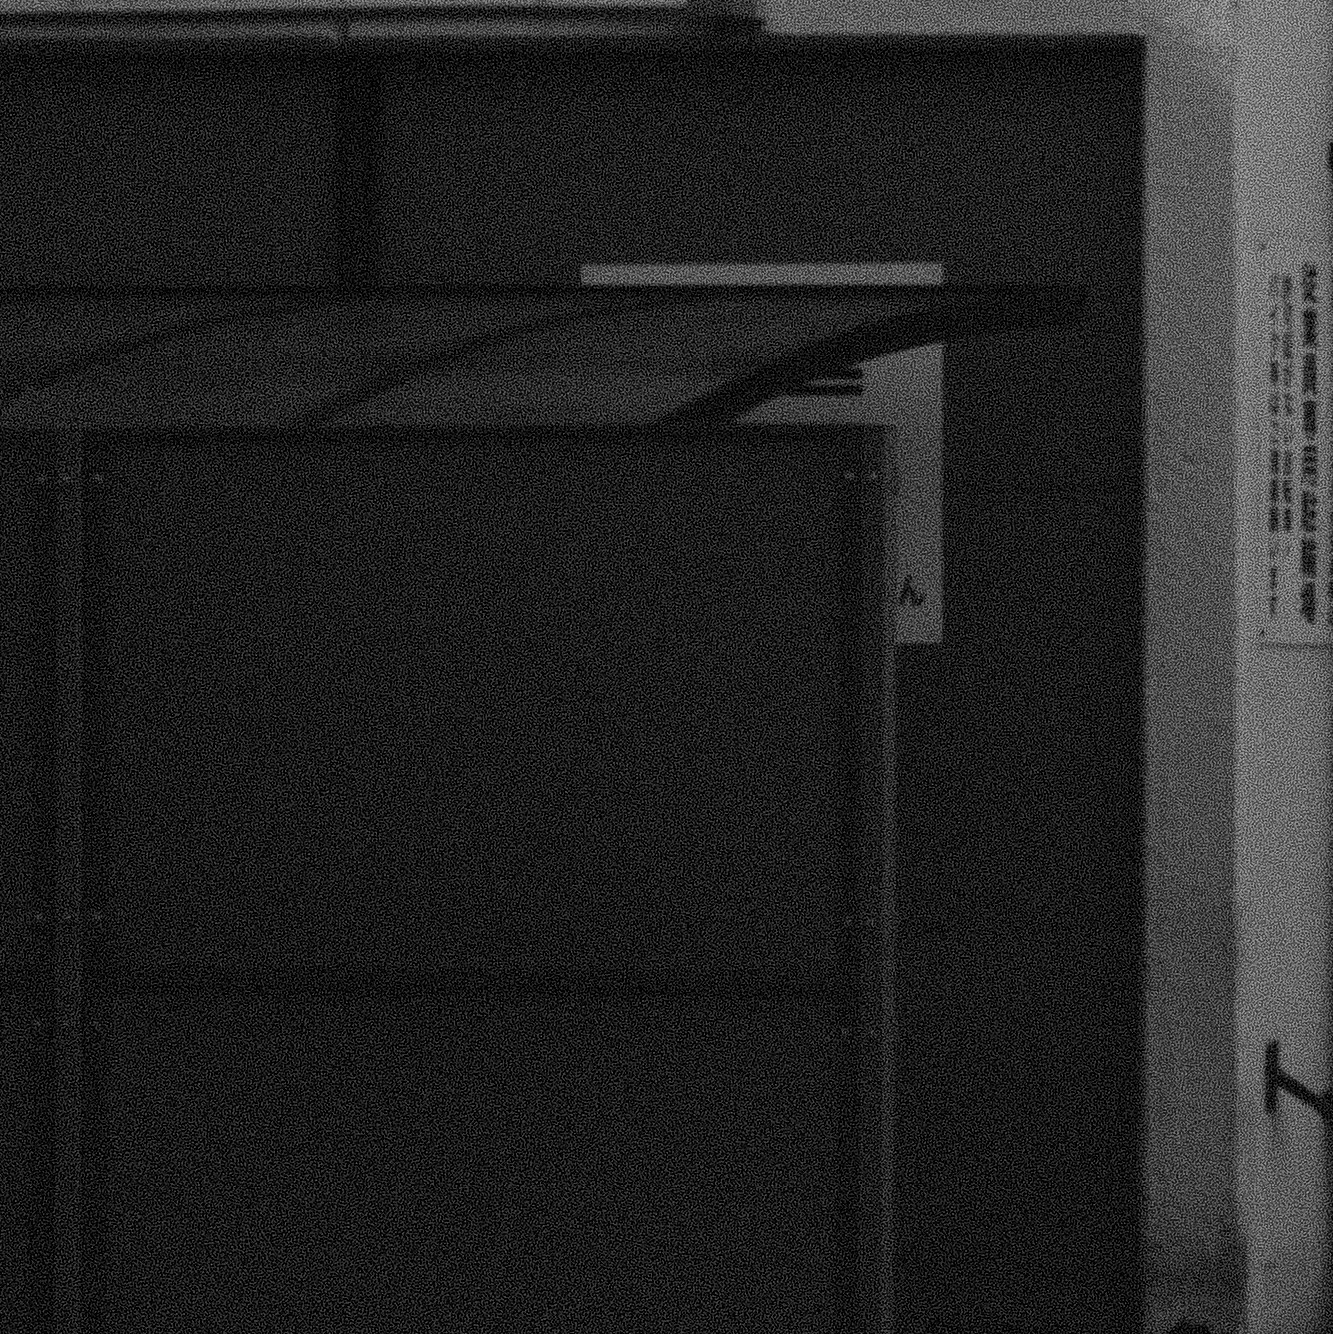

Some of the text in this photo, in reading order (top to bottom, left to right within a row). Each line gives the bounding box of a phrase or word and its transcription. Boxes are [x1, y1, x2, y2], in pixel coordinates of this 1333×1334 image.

[1301, 265, 1318, 622] 従業員専用駐輪場
